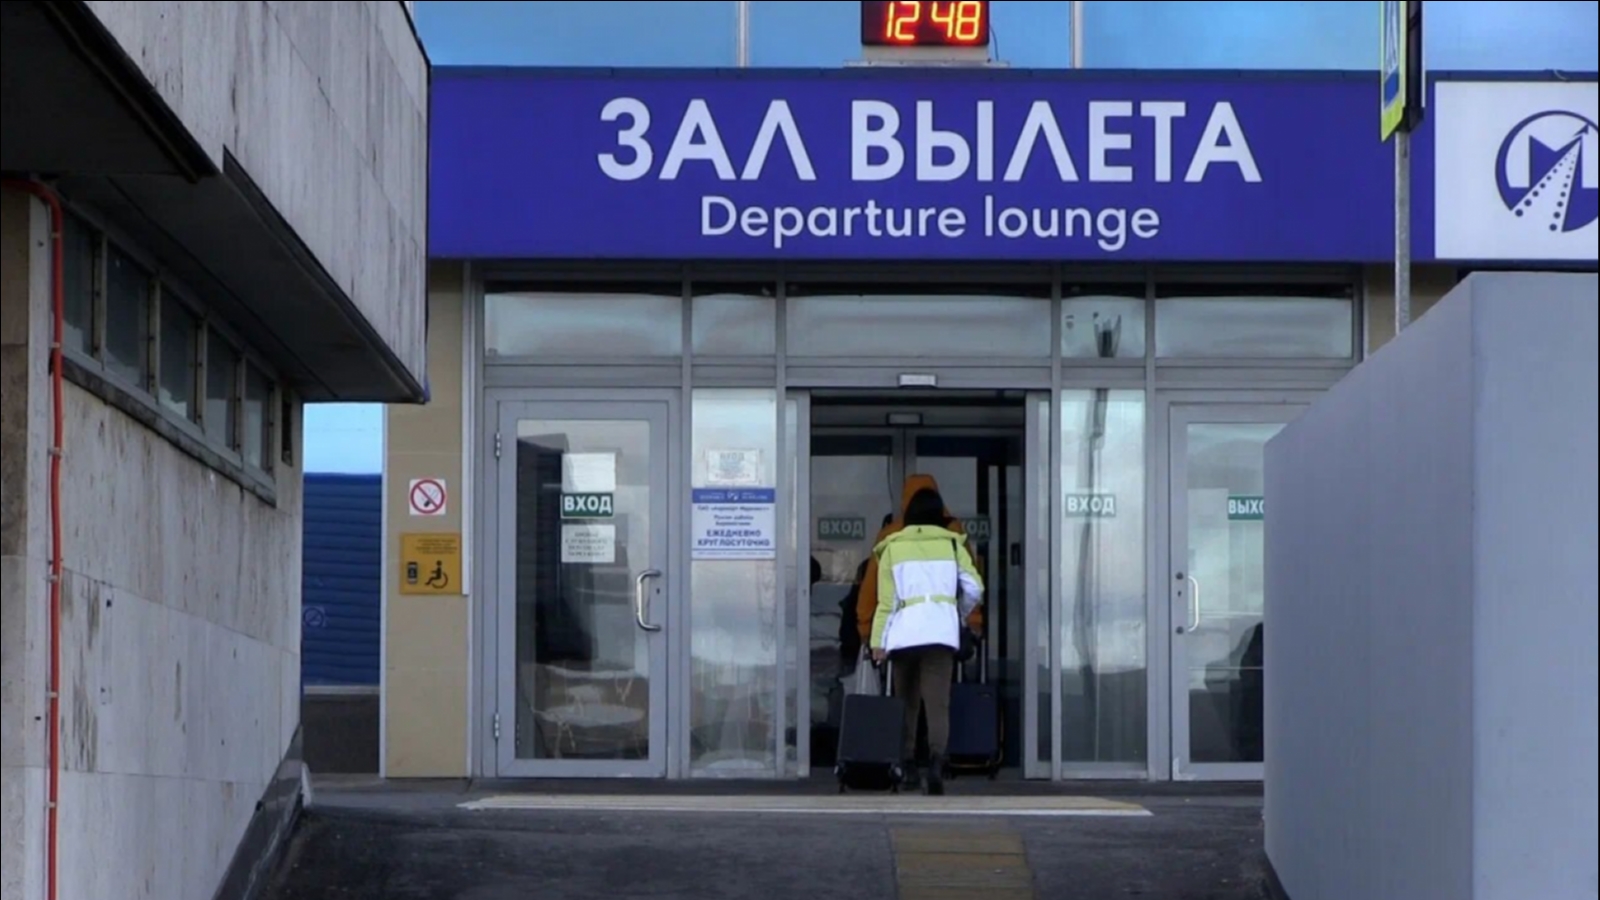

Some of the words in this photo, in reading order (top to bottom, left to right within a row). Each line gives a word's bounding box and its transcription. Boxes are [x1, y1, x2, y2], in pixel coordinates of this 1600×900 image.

[598, 97, 817, 181] ЗАЛ
[851, 100, 1263, 182] ВЫЛЕТА
[701, 195, 966, 249] Departure
[984, 194, 1160, 251] lounge
[564, 495, 612, 514] ВХОД
[1067, 496, 1115, 514] ВХОД
[706, 529, 761, 538] ЕЖЕДНЕВНО
[819, 519, 864, 537] ВХОД
[697, 539, 770, 547] КРУГЛОСУТОЧНО
